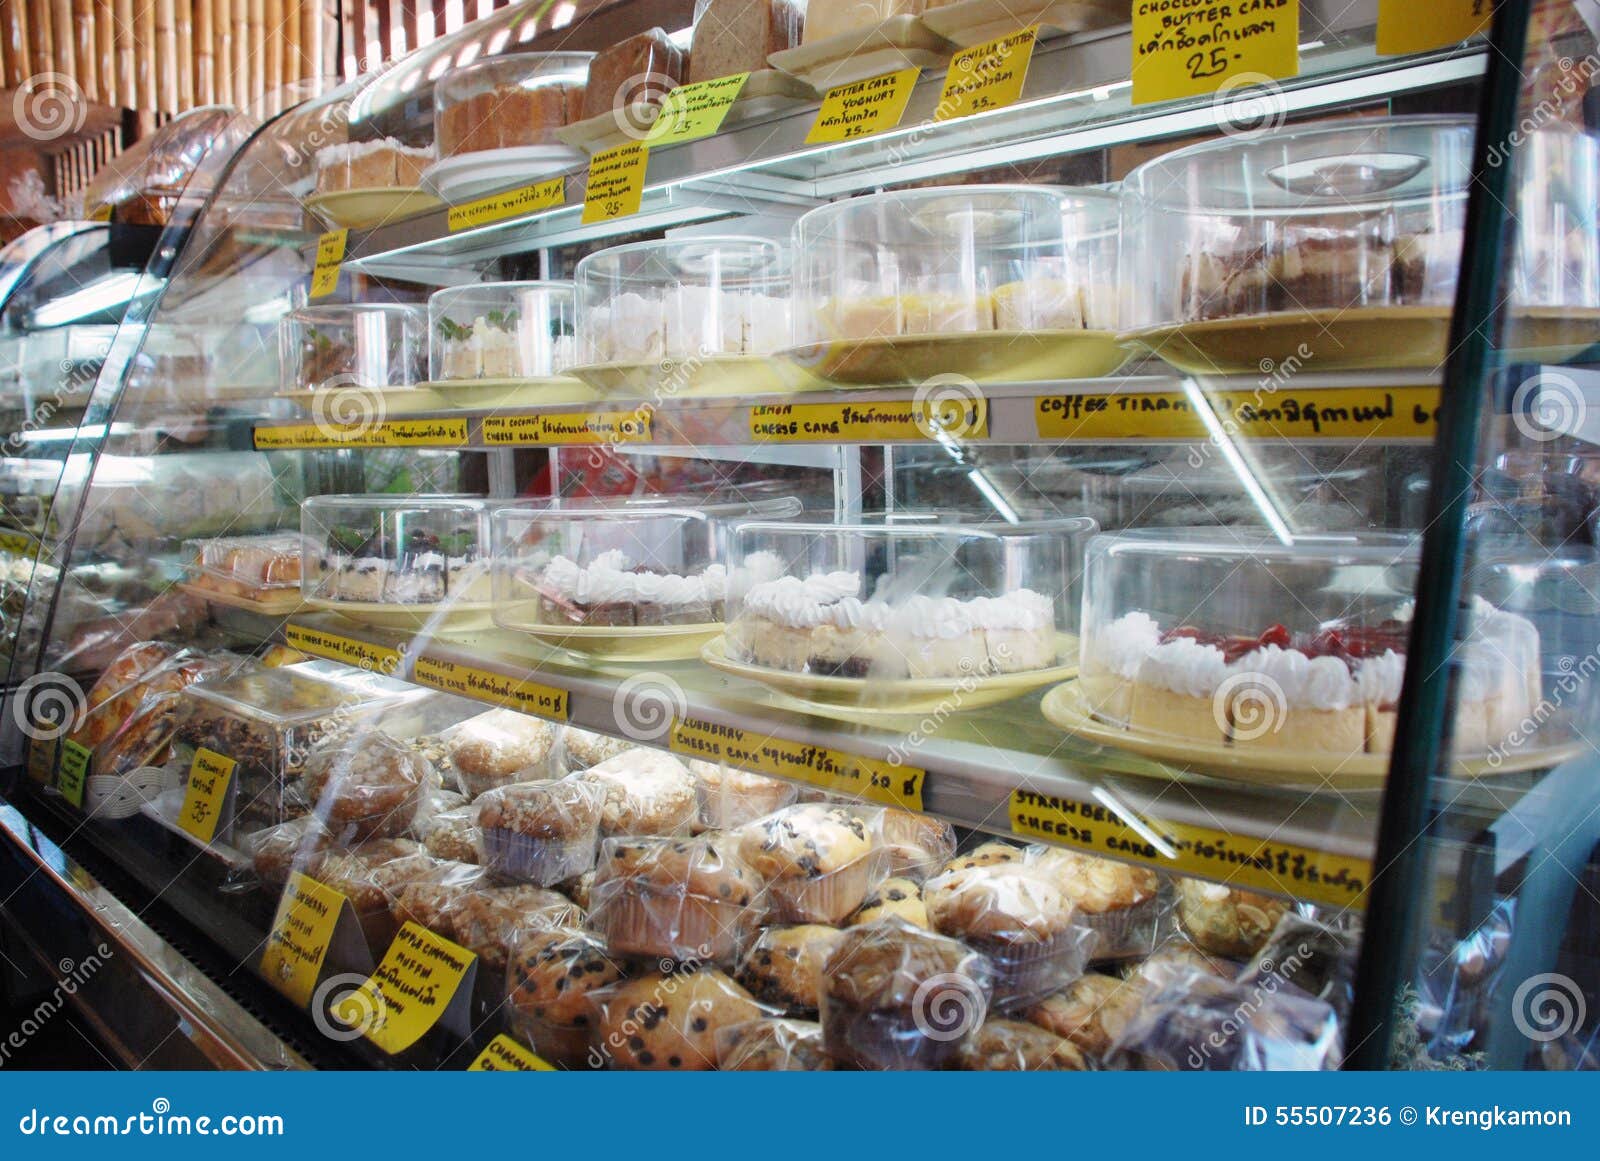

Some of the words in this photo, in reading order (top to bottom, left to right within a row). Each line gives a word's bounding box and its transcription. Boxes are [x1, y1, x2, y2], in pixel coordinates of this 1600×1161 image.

[1162, 6, 1232, 28] BUTTER
[1239, 0, 1287, 15] CAKE
[828, 83, 865, 99] BUTTER
[867, 75, 897, 90] CAKE
[842, 90, 895, 109] YOGHURT
[753, 404, 792, 416] LEMON
[804, 421, 840, 434] CAKE
[677, 732, 721, 756] CHEESE
[726, 746, 760, 764] CAKE
[1017, 813, 1093, 843] CHEESE
[396, 952, 432, 978] MUFFIN
